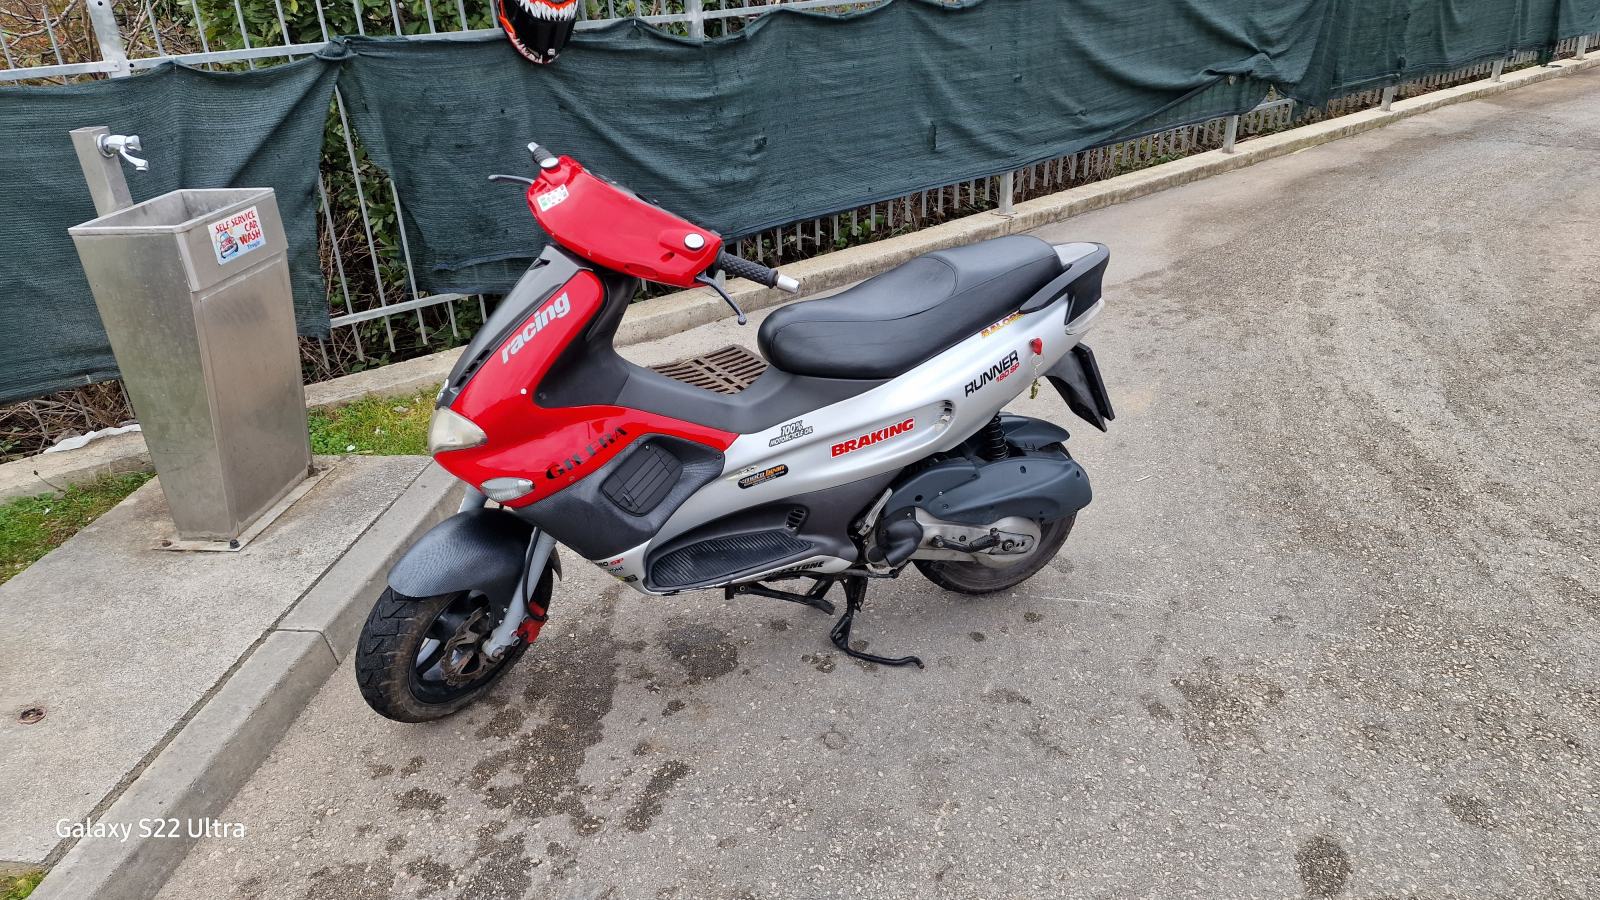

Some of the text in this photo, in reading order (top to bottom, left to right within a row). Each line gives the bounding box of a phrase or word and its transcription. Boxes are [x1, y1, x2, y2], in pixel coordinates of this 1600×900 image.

[216, 210, 256, 234] SELF SERVICE
[239, 229, 262, 245] WASH
[244, 220, 259, 232] CAR
[501, 292, 570, 364] racing
[964, 350, 1019, 397] RUNNER
[780, 420, 803, 437] 100%
[831, 418, 914, 458] BRAKING
[546, 427, 627, 479] GILERA
